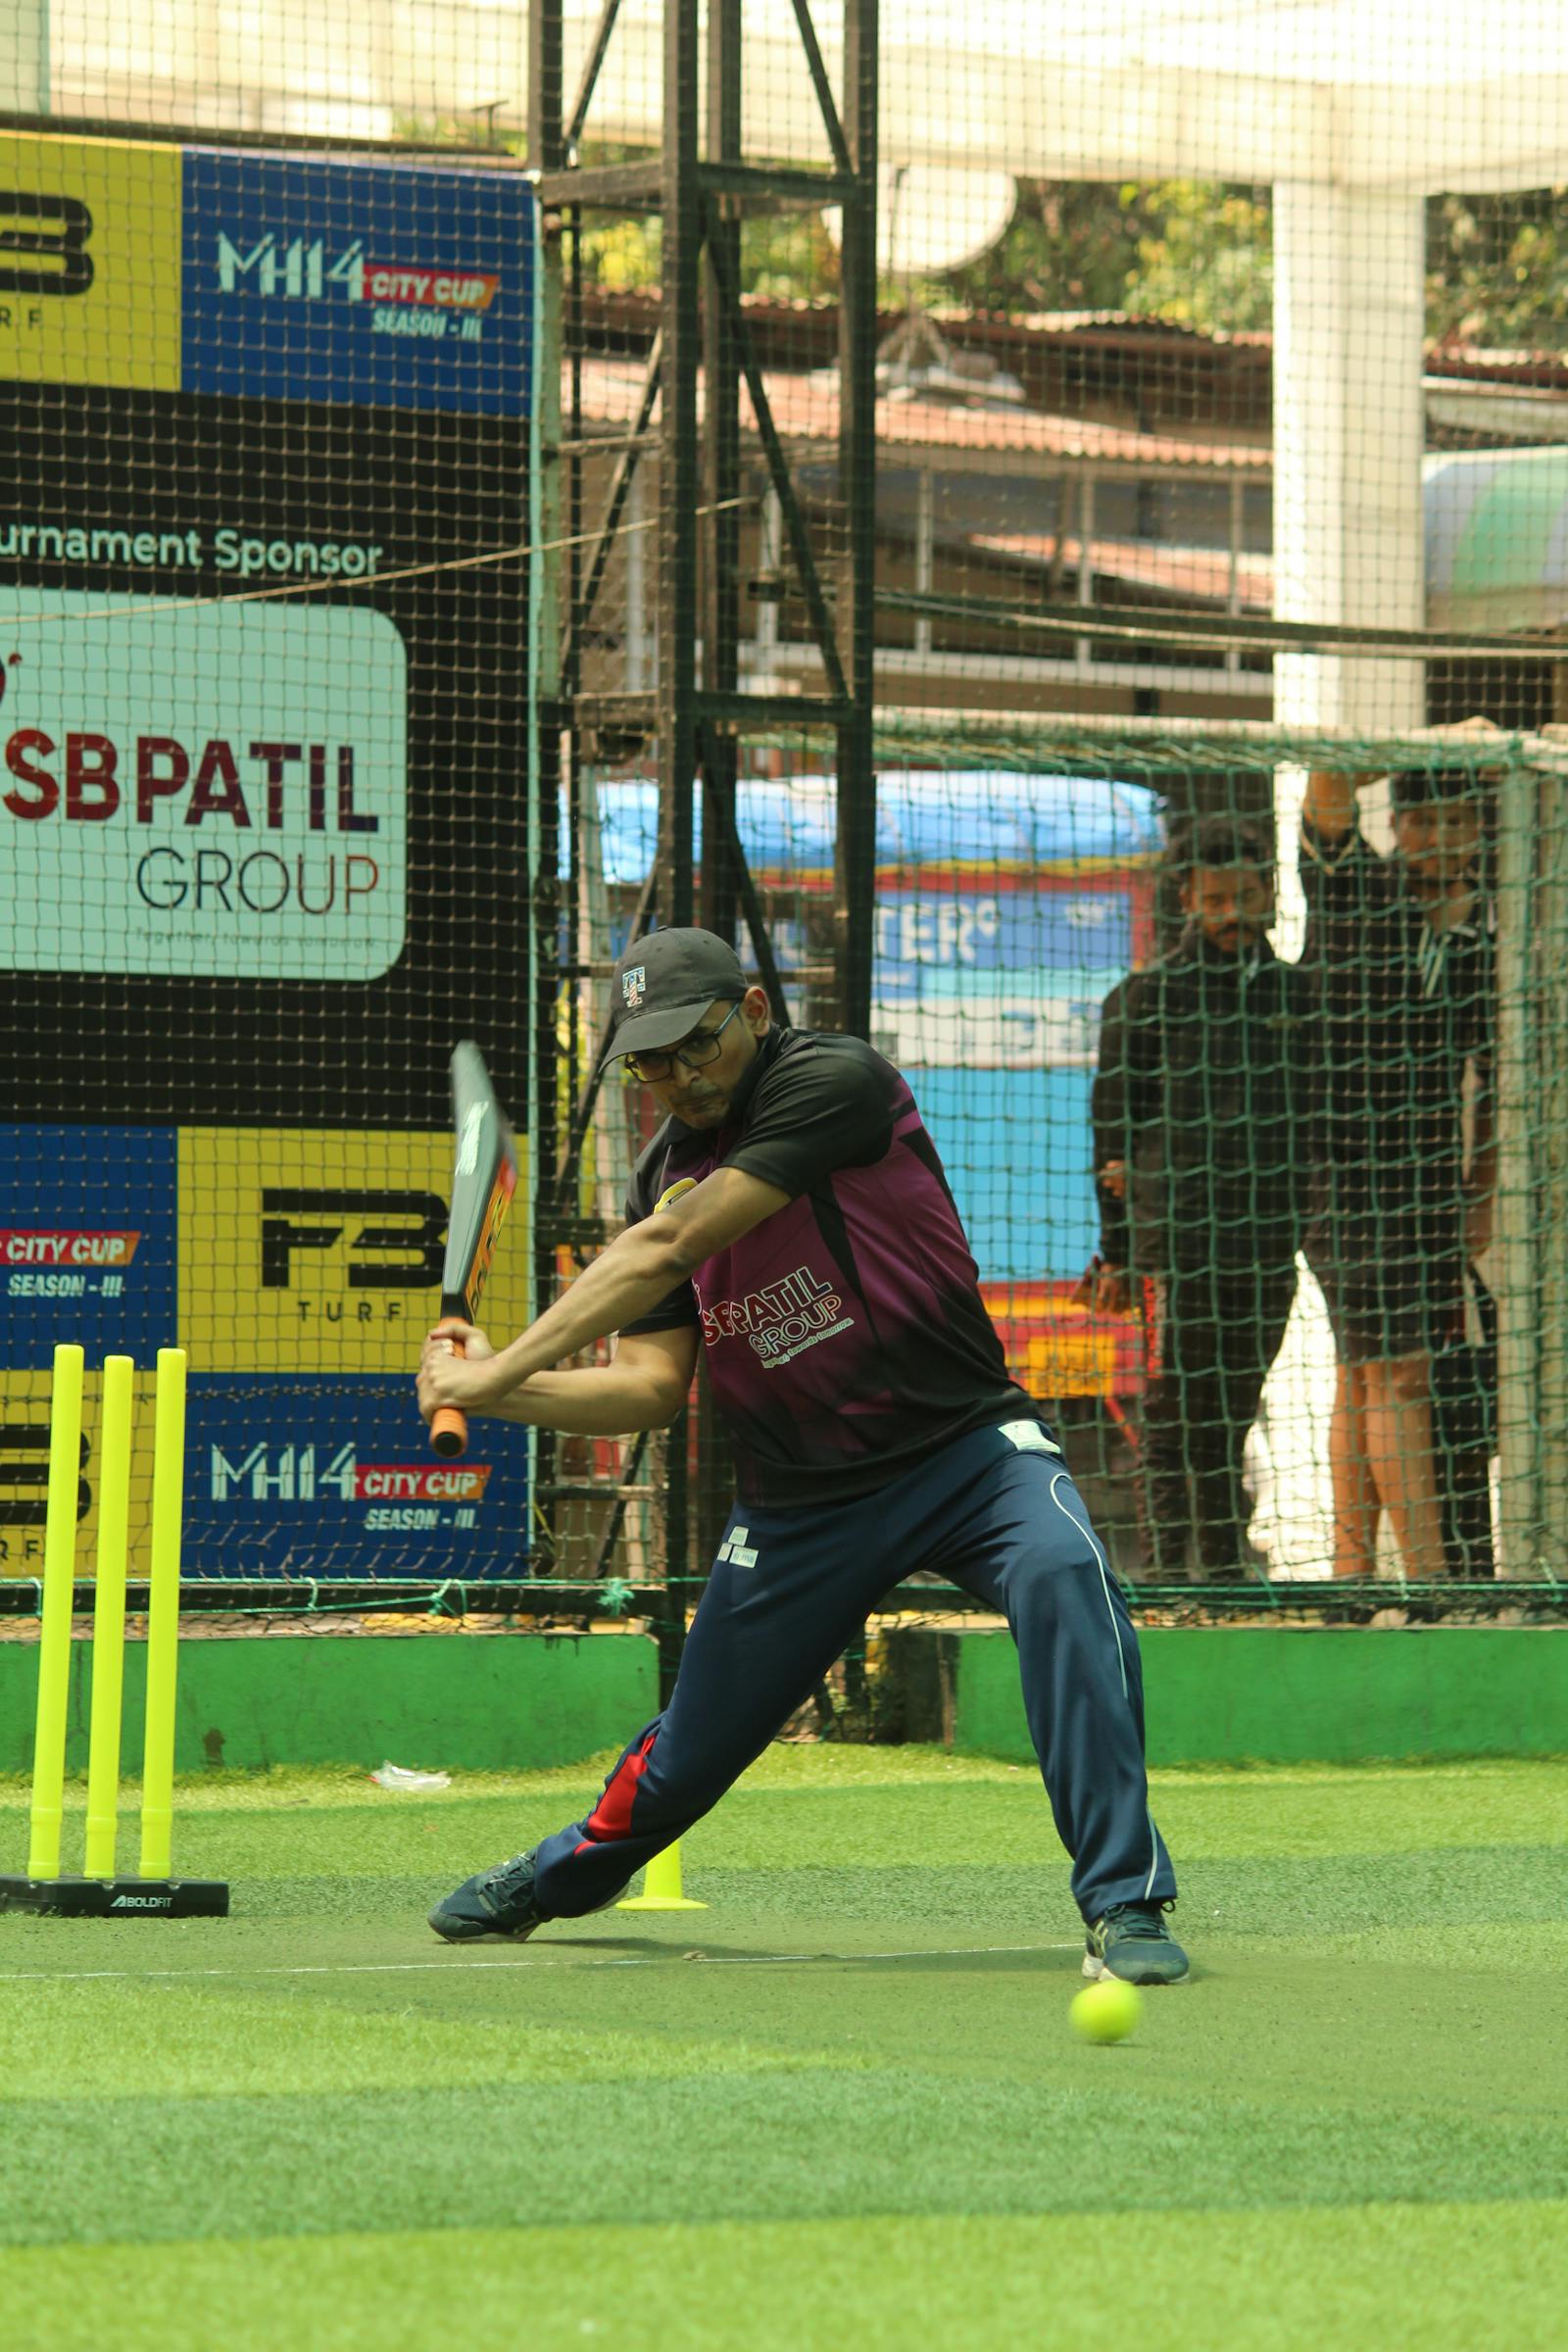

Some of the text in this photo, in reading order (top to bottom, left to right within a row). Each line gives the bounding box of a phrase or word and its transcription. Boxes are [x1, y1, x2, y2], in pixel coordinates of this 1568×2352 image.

[371, 270, 429, 301] CITY
[433, 277, 486, 304] CUP
[0, 306, 42, 330] RF
[372, 309, 447, 337] SEASON
[0, 523, 383, 577] urnament Sponsor
[136, 847, 379, 914] GROUP
[7, 1237, 125, 1262] CITY CUP
[8, 1274, 85, 1298] SEASON
[298, 1301, 402, 1322] TURF
[749, 1295, 842, 1358] GROUP
[364, 1472, 421, 1495] CITY
[425, 1472, 478, 1496] CUP
[365, 1508, 439, 1531] SEASON
[0, 1540, 39, 1560] RF
